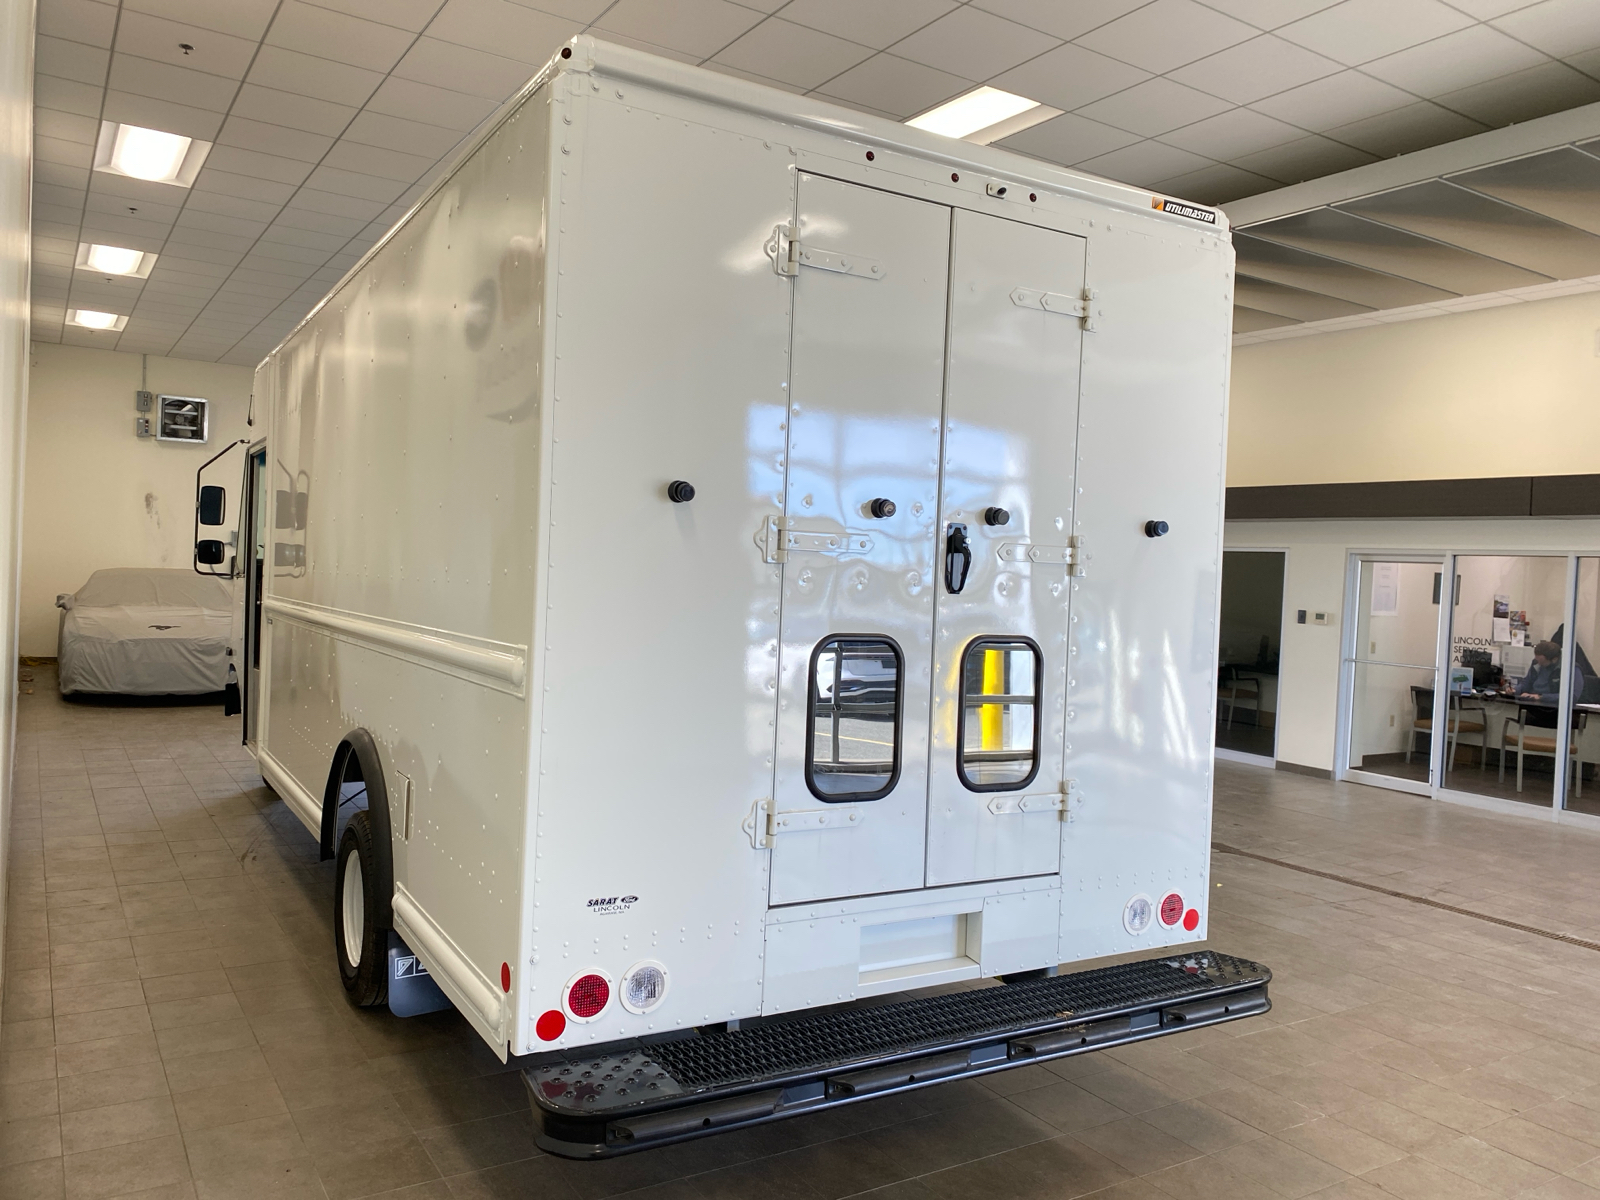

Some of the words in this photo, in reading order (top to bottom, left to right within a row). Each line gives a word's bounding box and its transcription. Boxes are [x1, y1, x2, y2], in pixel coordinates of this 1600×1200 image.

[1165, 203, 1214, 222] UTILIMASTER
[1453, 636, 1491, 646] LINCOLN
[1453, 645, 1488, 654] SERVICE
[587, 897, 619, 907] SARAT
[593, 904, 630, 912] LINCOLN
